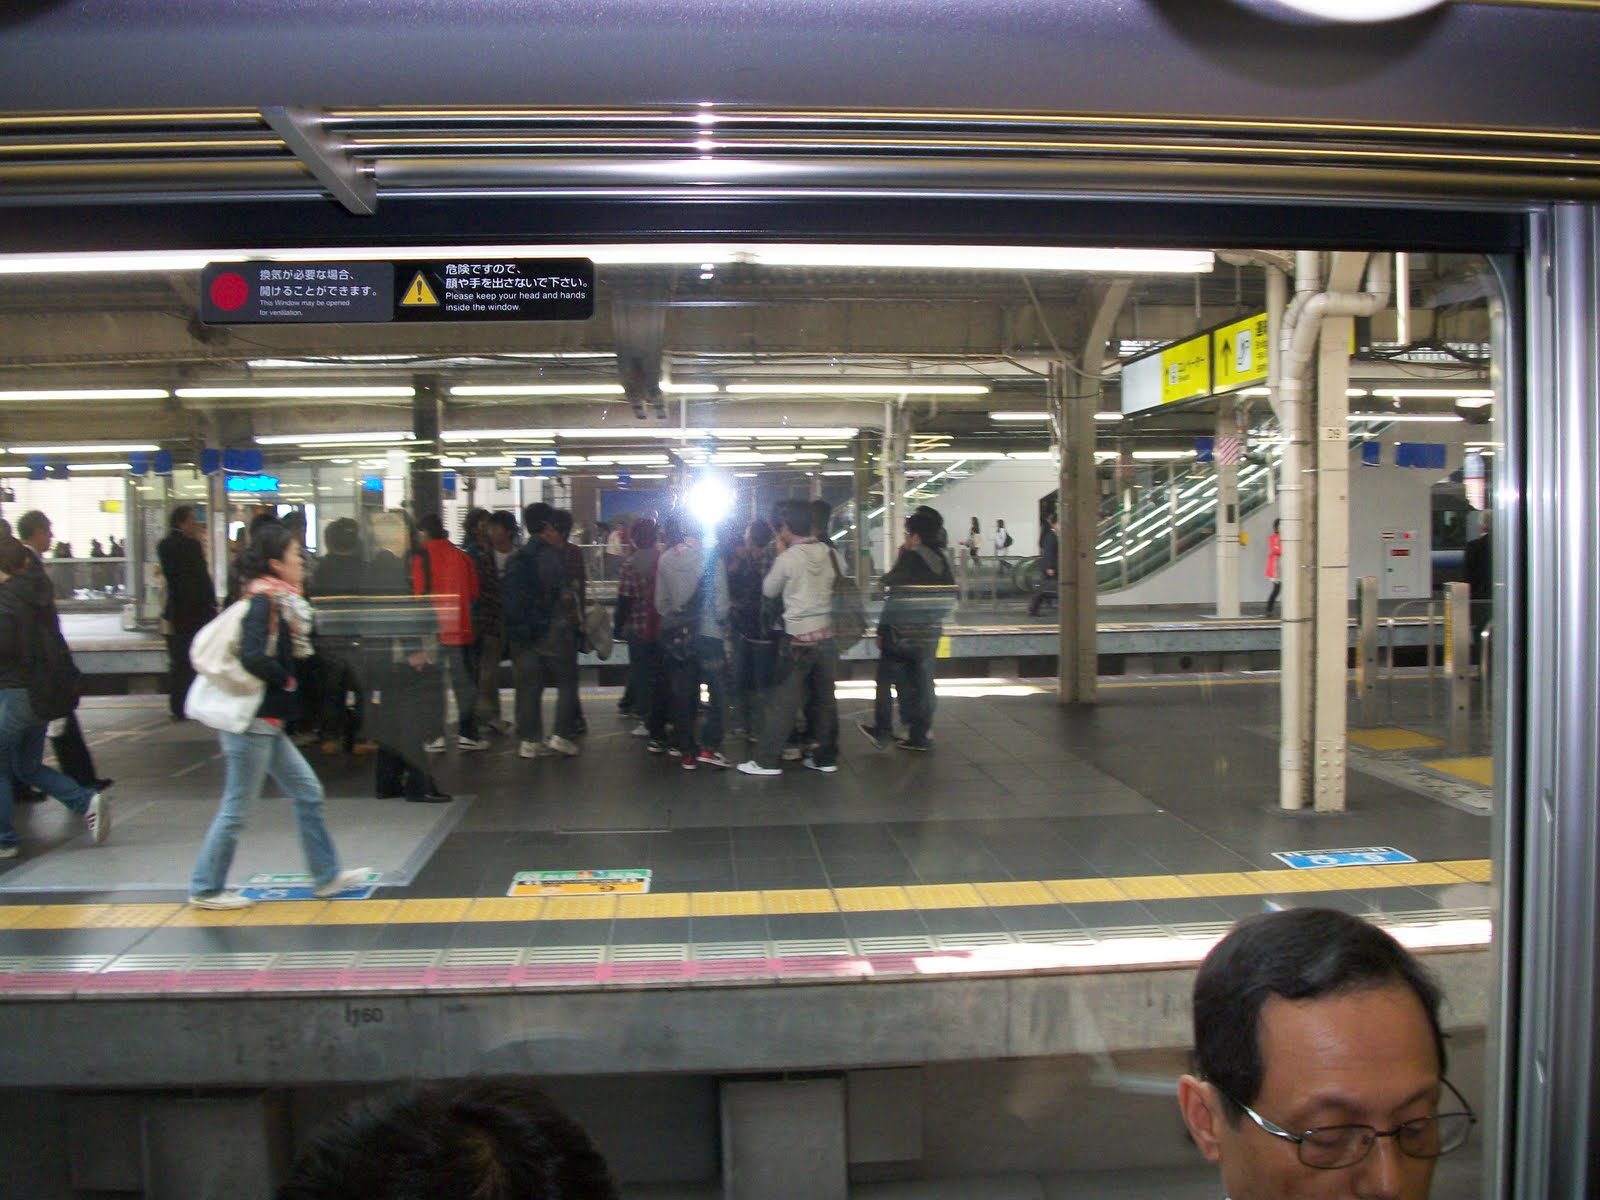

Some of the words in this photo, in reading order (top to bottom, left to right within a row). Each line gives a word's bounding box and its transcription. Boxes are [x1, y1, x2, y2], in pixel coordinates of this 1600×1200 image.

[260, 269, 355, 281] 換気が必要な場合、
[445, 264, 521, 275] 危険ですので、
[445, 277, 588, 289] 顔や手を出さないで下さい。
[259, 286, 377, 297] 開けることができます。
[445, 292, 474, 300] Please
[476, 292, 497, 302] keep
[499, 293, 517, 302] your
[519, 291, 540, 299] head
[542, 291, 558, 299] and
[560, 291, 586, 299] hands
[445, 303, 470, 311] inside
[472, 303, 486, 311] the
[488, 303, 521, 311] window.
